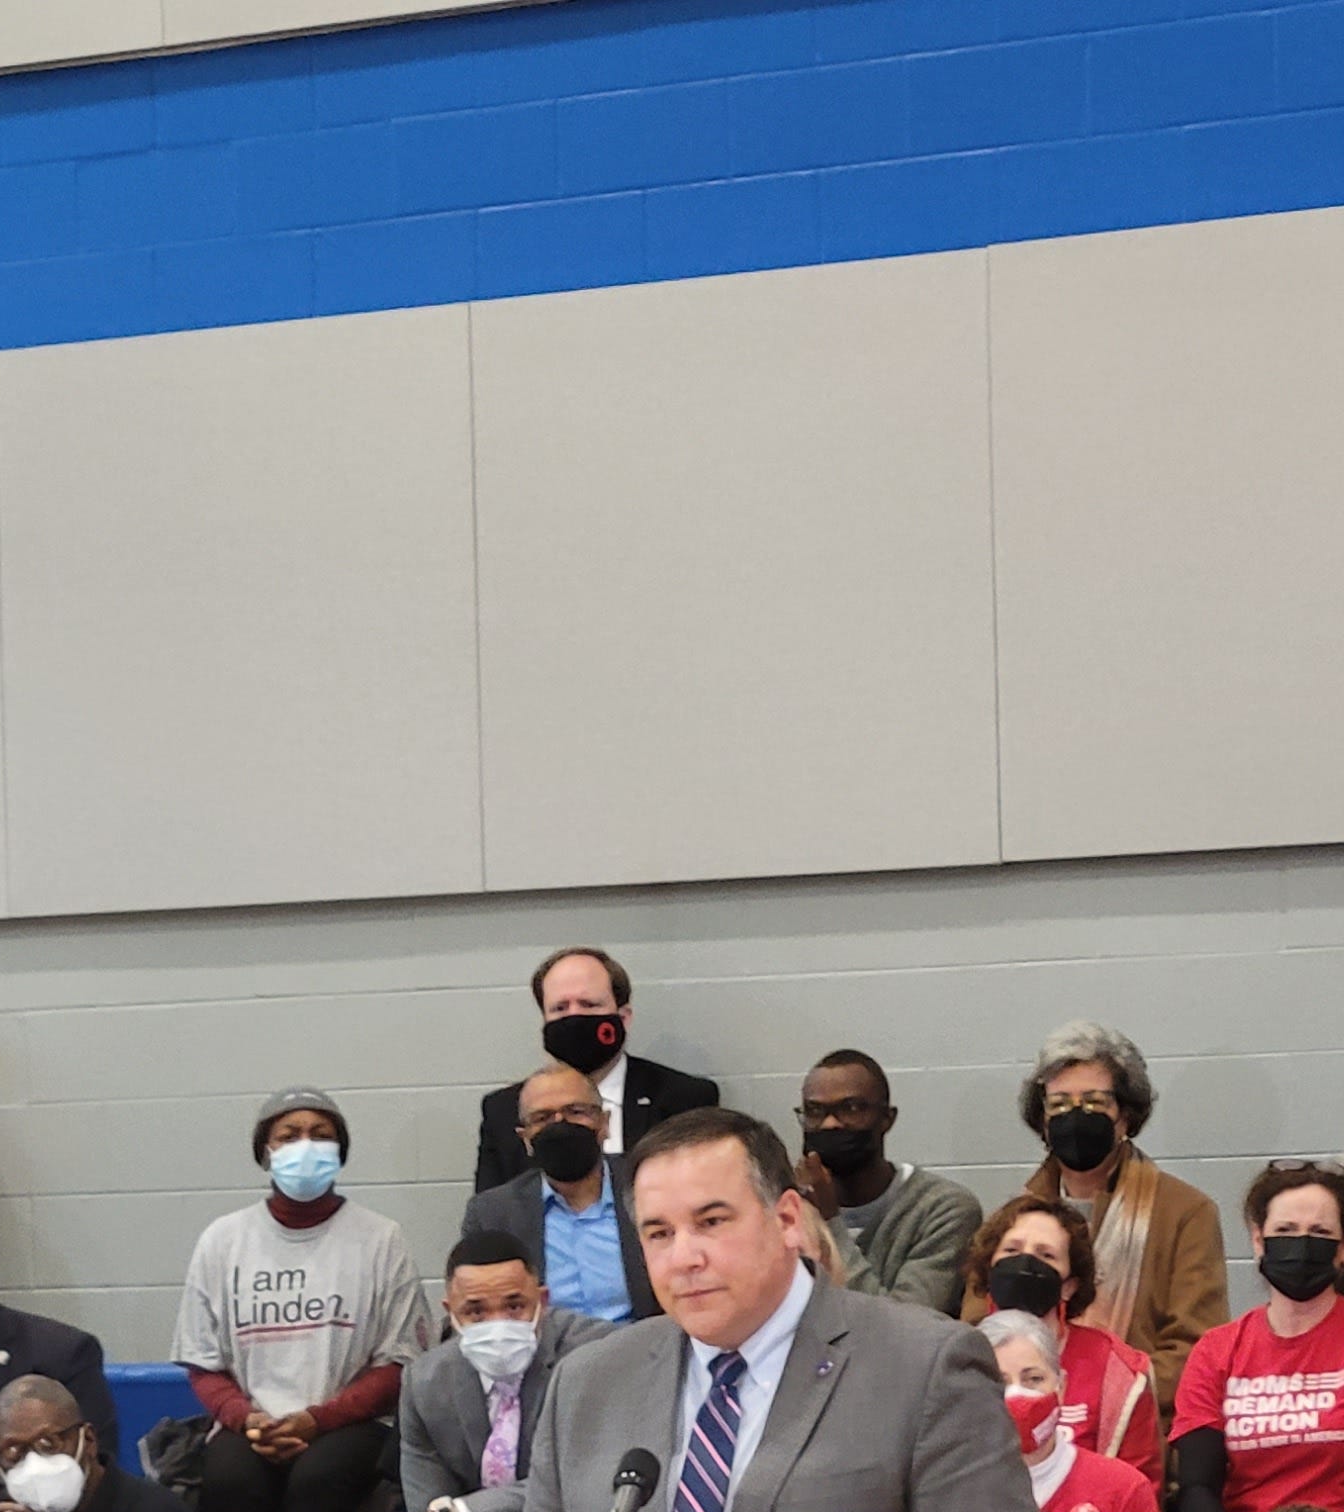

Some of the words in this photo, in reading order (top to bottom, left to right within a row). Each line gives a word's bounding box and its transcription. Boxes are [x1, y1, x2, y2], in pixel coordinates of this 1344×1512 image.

[233, 1266, 240, 1295] I
[253, 1268, 306, 1292] am
[1226, 1372, 1304, 1396] MOMS
[1222, 1391, 1336, 1416] DEMAND
[1224, 1411, 1319, 1437] ACTION
